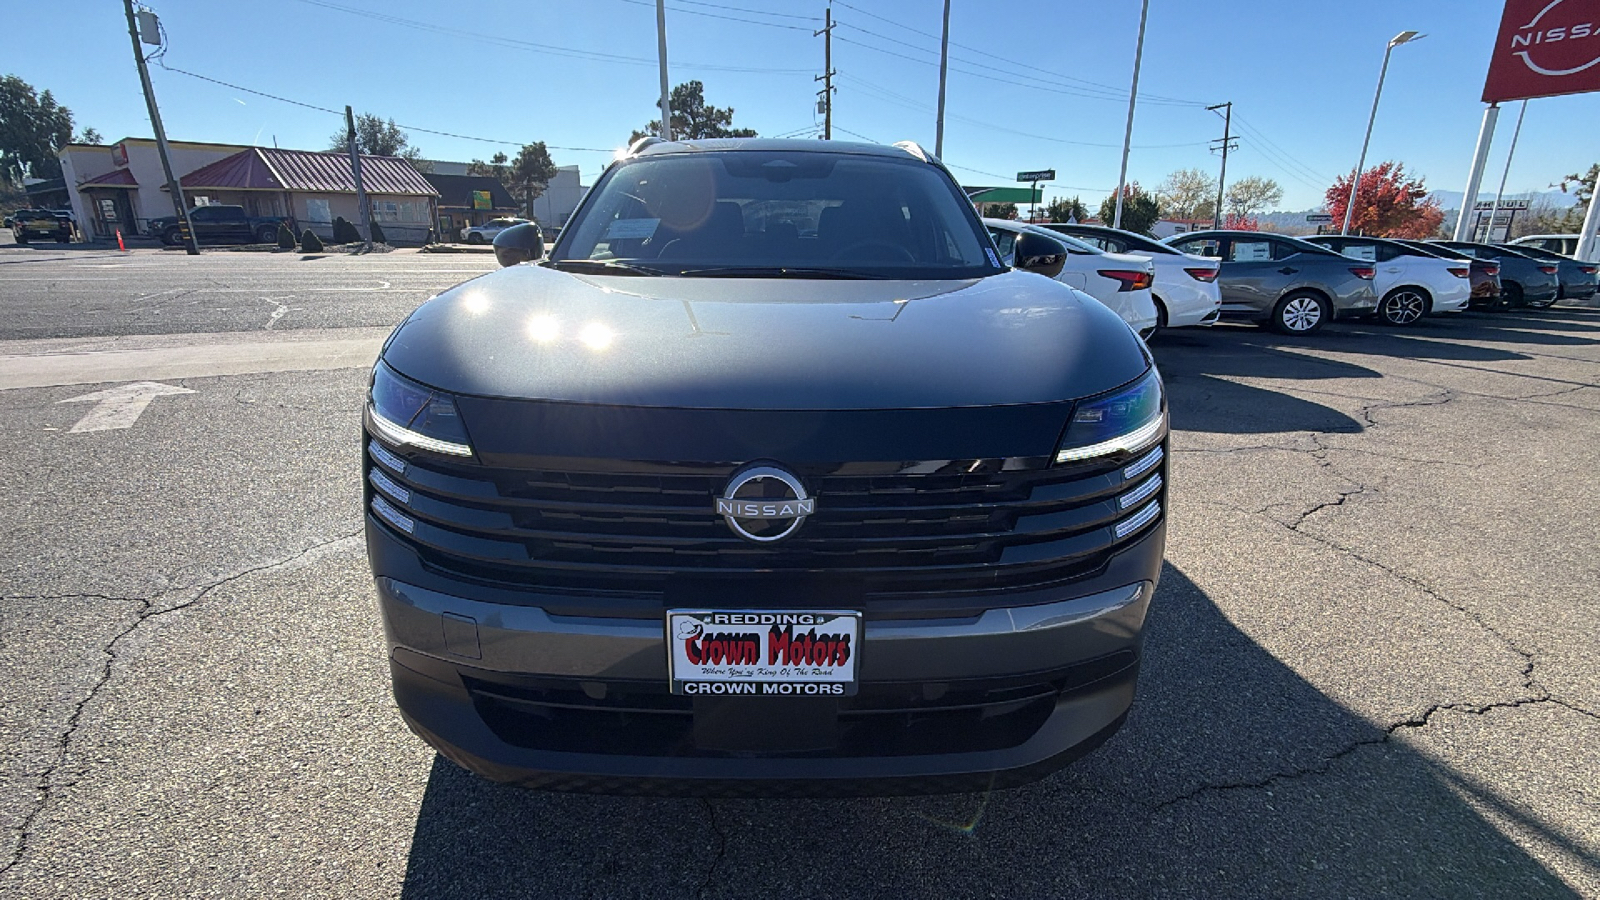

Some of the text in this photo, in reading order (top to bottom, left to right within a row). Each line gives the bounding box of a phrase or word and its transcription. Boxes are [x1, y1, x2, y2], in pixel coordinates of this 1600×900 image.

[719, 501, 812, 516] NISSAN
[714, 614, 814, 625] REDDING
[684, 625, 851, 667] Crown Motors
[701, 667, 726, 675] Where
[757, 667, 777, 677] King
[780, 667, 791, 677] Of
[794, 667, 809, 676] The
[811, 667, 834, 676] Road
[684, 682, 844, 696] CROWN MOTORS
